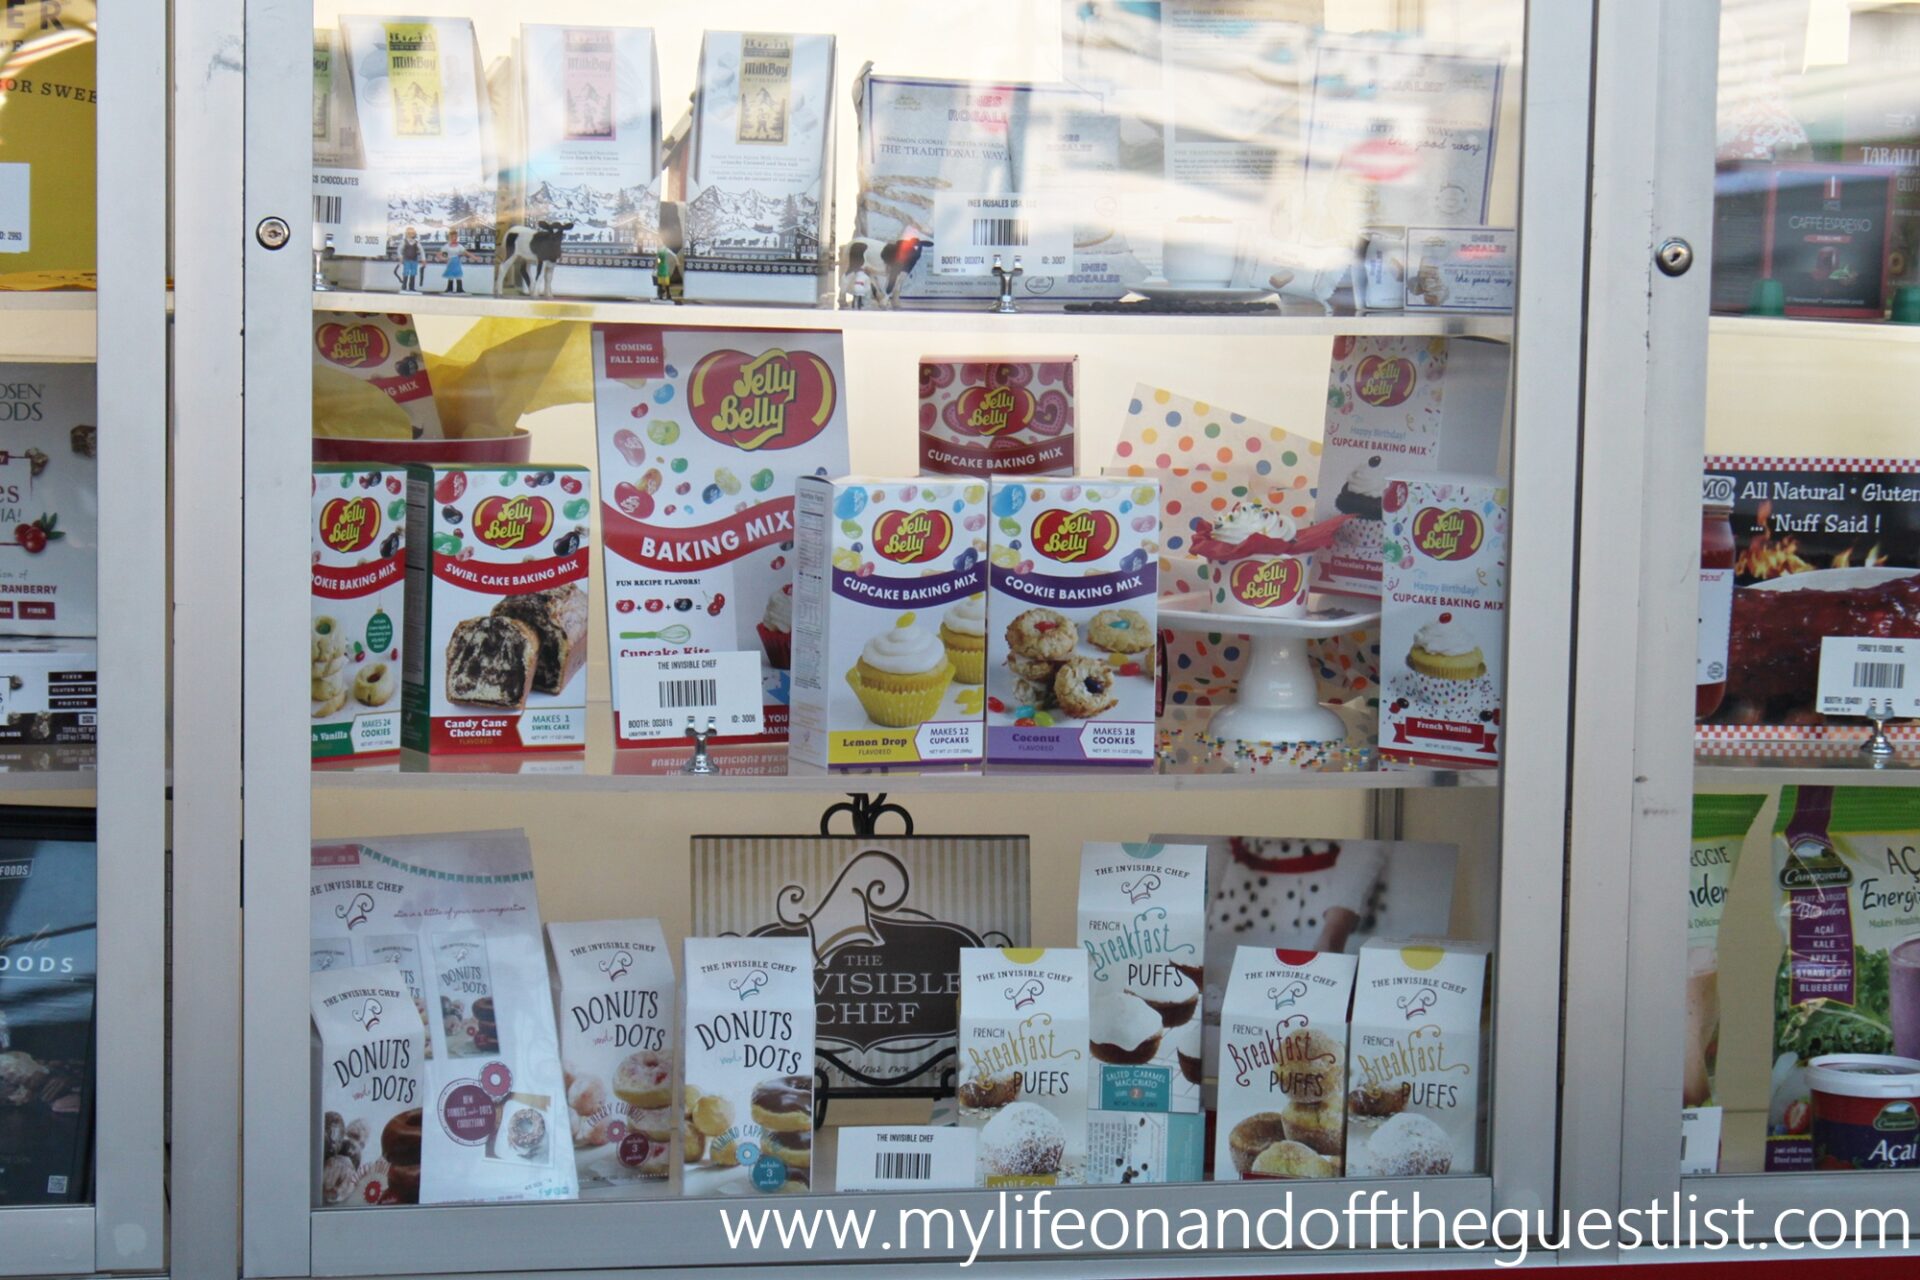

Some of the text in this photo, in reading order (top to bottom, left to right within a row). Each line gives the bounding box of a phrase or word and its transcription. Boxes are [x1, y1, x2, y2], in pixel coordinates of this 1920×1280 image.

[744, 62, 790, 77] MilkBoy
[880, 144, 977, 160] THE TRADITIONAL
[321, 175, 359, 186] CHOCOLATES
[983, 199, 1009, 209] ROSALES
[1823, 217, 1873, 234] ESPRESSO
[338, 326, 370, 347] Jelly
[331, 343, 368, 362] Belly
[615, 343, 653, 352] COMING
[610, 355, 634, 364] FALL
[1373, 360, 1400, 383] Jelly
[733, 360, 798, 403] Jelly
[1362, 376, 1395, 398] Belly
[980, 390, 1015, 412] Jelly
[711, 394, 787, 436] Belly
[967, 407, 1009, 428] Belly
[1332, 437, 1407, 454] CUPCAKE BAKING
[927, 447, 1065, 470] CUPCAKE BAKING MIX
[1741, 481, 1768, 501] All
[1773, 482, 1846, 502] Natural
[339, 503, 367, 525] Jelly
[498, 503, 534, 526] Jelly
[1825, 514, 1869, 533] Said
[329, 520, 360, 544] Belly
[484, 520, 527, 544] Belly
[897, 513, 932, 538] Jelly
[1058, 513, 1097, 538] Jelly
[1433, 513, 1466, 538] Jelly
[640, 529, 741, 563] BAKING
[884, 530, 925, 556] Belly
[1044, 530, 1089, 556] Belly
[1421, 530, 1460, 552] Belly
[339, 561, 398, 589] BAKING MIX
[444, 559, 580, 587] SWIRL CAKE BAKING MIX
[1254, 562, 1288, 583] Jelly
[634, 579, 662, 587] RECIPE
[664, 578, 701, 586] FLAVORS!
[843, 571, 979, 602] CUPCAKE BAKING MIX
[1005, 574, 1143, 601] COOKIE BAKING MIX
[1241, 578, 1282, 600] Belly
[1393, 592, 1505, 611] CUPCAKE BAKING MIX
[658, 659, 718, 671] THE INVISIBLE CHEF
[444, 719, 508, 730] Candy Cane
[532, 714, 561, 723] MAKES
[769, 714, 789, 724] YOU
[1417, 720, 1473, 735] French Vanilla
[361, 728, 391, 738] COOKIES
[449, 728, 503, 738] Chocolate
[929, 736, 970, 745] CUPCAKES
[930, 728, 969, 736] MAKES 12
[1012, 733, 1060, 743] Coconut
[1092, 736, 1136, 745] COOKIES
[1093, 727, 1136, 736] MAKES 18
[842, 738, 908, 748] Lemon Drop
[1094, 864, 1190, 879] THE INVISIBLE CHEF
[325, 880, 404, 894] INVISIBLE CHEF
[1089, 920, 1121, 931] FRENCH
[570, 942, 656, 957] THE INVISIBLE CHEF
[1084, 907, 1195, 982] Breakfast
[1812, 940, 1836, 949] KALE
[700, 960, 797, 974] THE INVISIBLE CHEF
[843, 955, 883, 967] THE
[1810, 953, 1838, 963] APPLE
[441, 966, 482, 987] DONUTS
[977, 969, 1073, 984] THE INVISIBLE CHEF
[1128, 963, 1183, 988] PUFFS
[1245, 970, 1338, 989] THE INVISIBLE CHEF
[1796, 968, 1852, 978] STRAWBERRY
[463, 981, 487, 996] DOTS
[1371, 977, 1468, 996] THE INVISIBLE CHEF
[1799, 983, 1848, 993] BLUEBERRY
[323, 988, 401, 1008] THE INVISIBLE CHEF
[571, 990, 659, 1033] DONUTS
[815, 1002, 920, 1025] CHEF
[615, 1023, 666, 1052] DOTS
[695, 1010, 793, 1051] DONUTS
[973, 1027, 1005, 1039] FRENCH
[1232, 1023, 1264, 1037] FRENCH
[968, 1012, 1081, 1090] Breakfast
[1227, 1014, 1336, 1087] Breakfast
[1362, 1035, 1395, 1048] FRENCH
[333, 1038, 410, 1089] DONUTS
[744, 1044, 802, 1076] DOTS
[1357, 1024, 1470, 1099] Breakfast
[1014, 1071, 1070, 1097] PUFFS
[1105, 1070, 1166, 1083] SALTED CARAMEL
[1269, 1070, 1324, 1097] PUFFS
[372, 1075, 416, 1104] DOTS
[1401, 1081, 1458, 1110] PUFFS
[877, 1133, 934, 1143] THE INVISIBLE CHEF
[766, 1168, 773, 1178] 3
